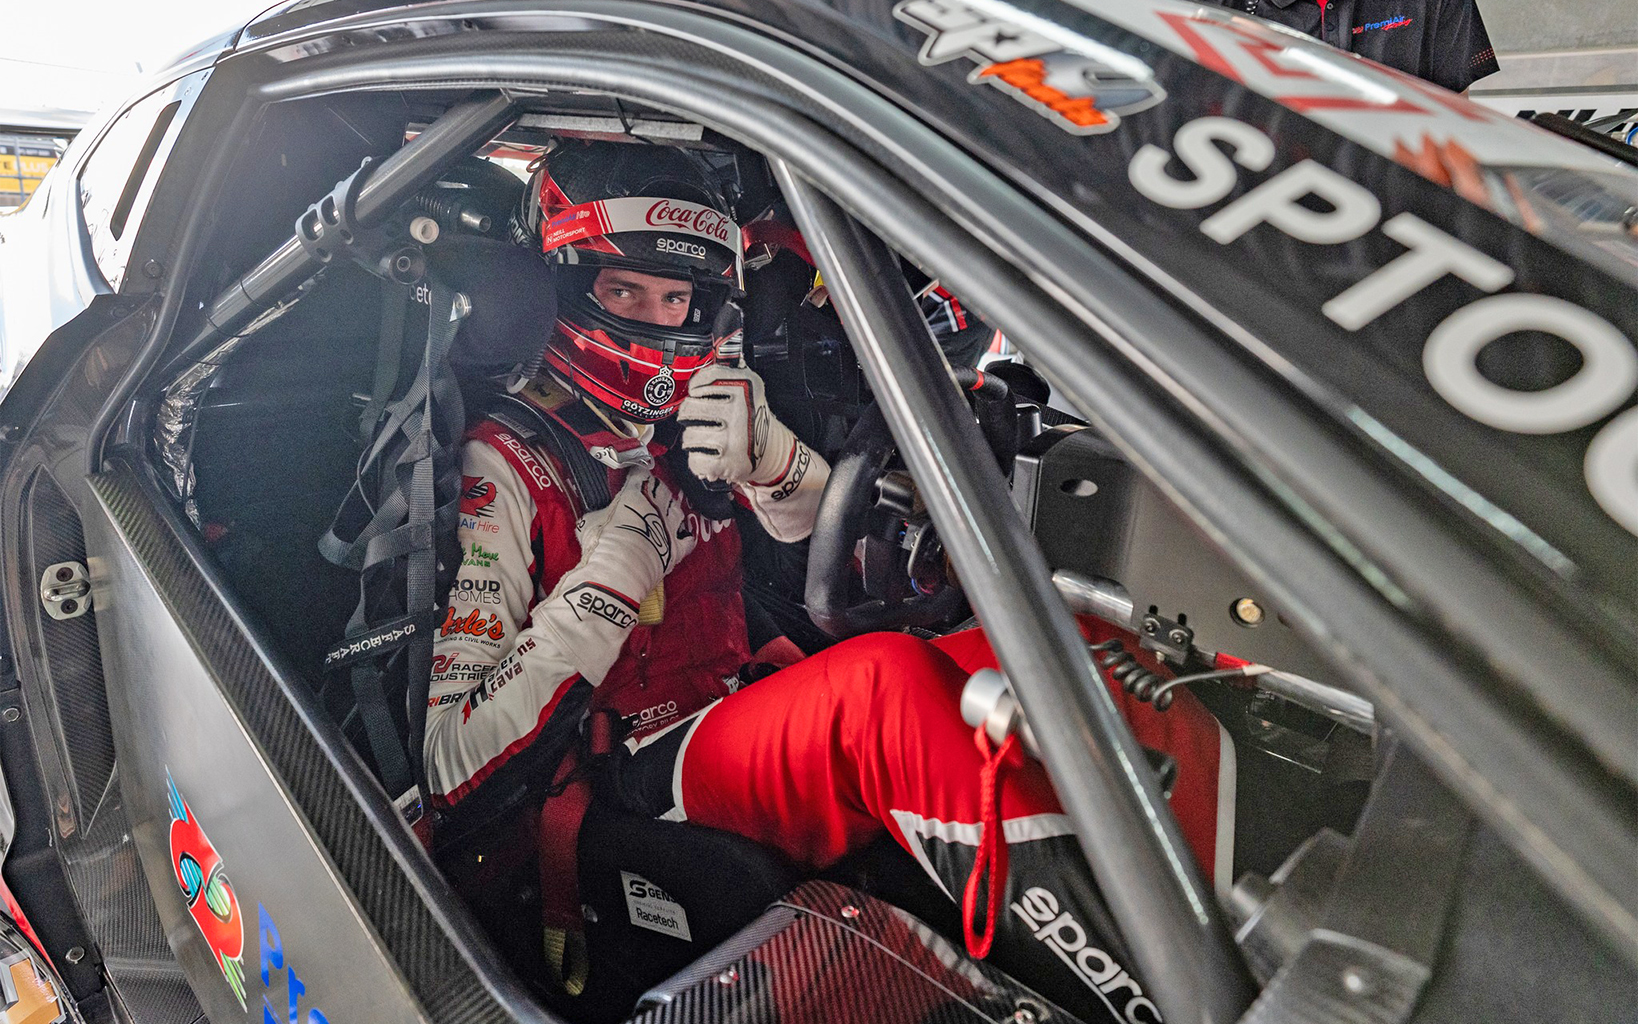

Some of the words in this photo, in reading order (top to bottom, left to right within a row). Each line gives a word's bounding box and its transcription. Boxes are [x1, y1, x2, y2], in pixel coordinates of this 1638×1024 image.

[645, 199, 729, 242] Coca-Cola
[656, 237, 706, 259] sparco
[1128, 116, 1638, 540] SPTO
[495, 433, 551, 490] sparco
[477, 520, 499, 533] Hire
[636, 906, 679, 930] Racetech
